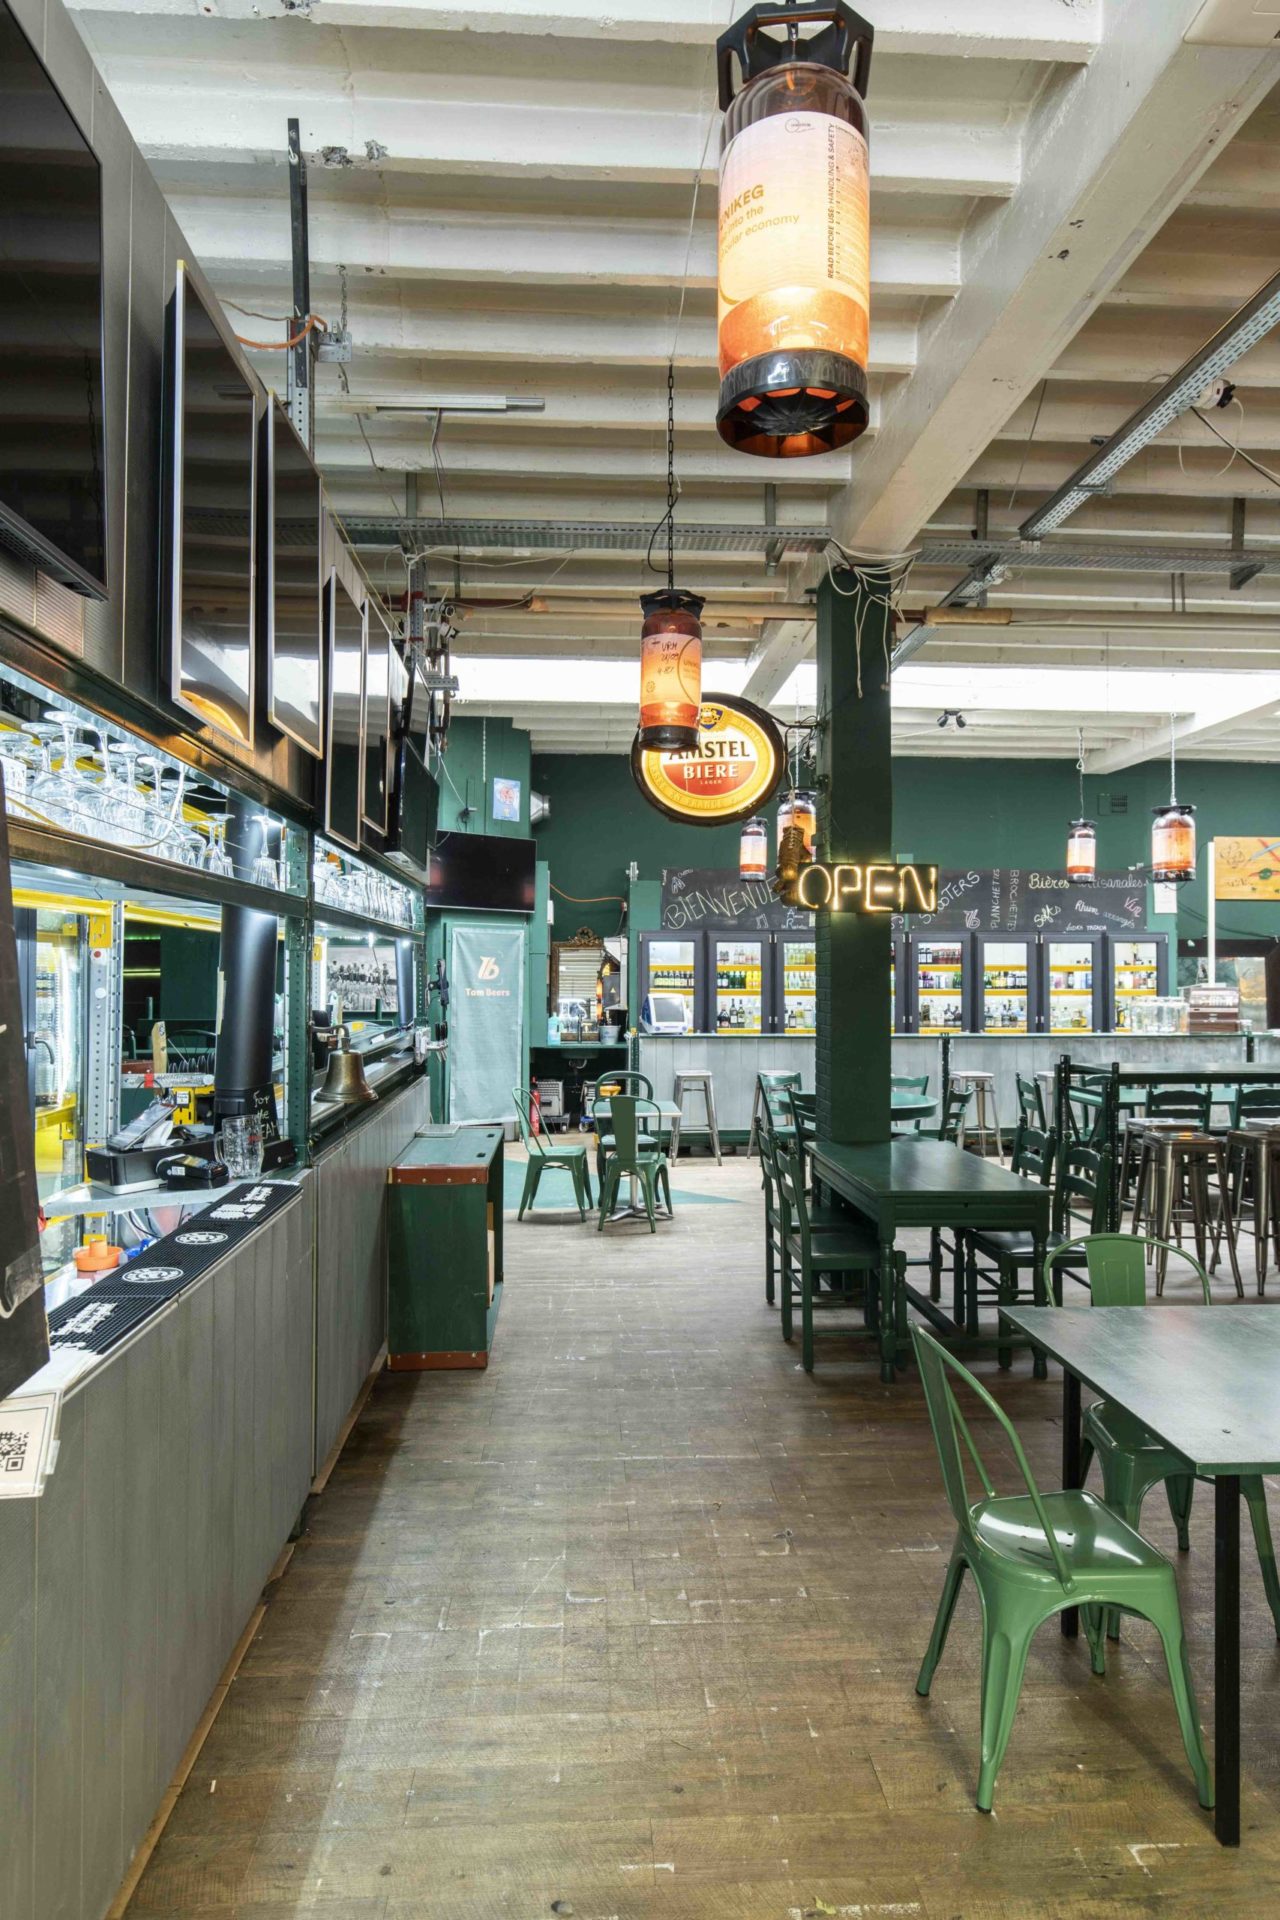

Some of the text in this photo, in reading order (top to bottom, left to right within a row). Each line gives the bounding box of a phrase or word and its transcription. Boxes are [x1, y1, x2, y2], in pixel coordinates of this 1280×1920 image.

[745, 214, 800, 237] economy
[683, 764, 739, 779] BIERE
[798, 864, 937, 912] OPEN
[1028, 872, 1070, 889] Bières
[664, 876, 781, 930] BIENVENUE
[919, 870, 981, 925] SOOTERS
[1124, 896, 1143, 918] Vin
[464, 988, 511, 997] Tom Beers
